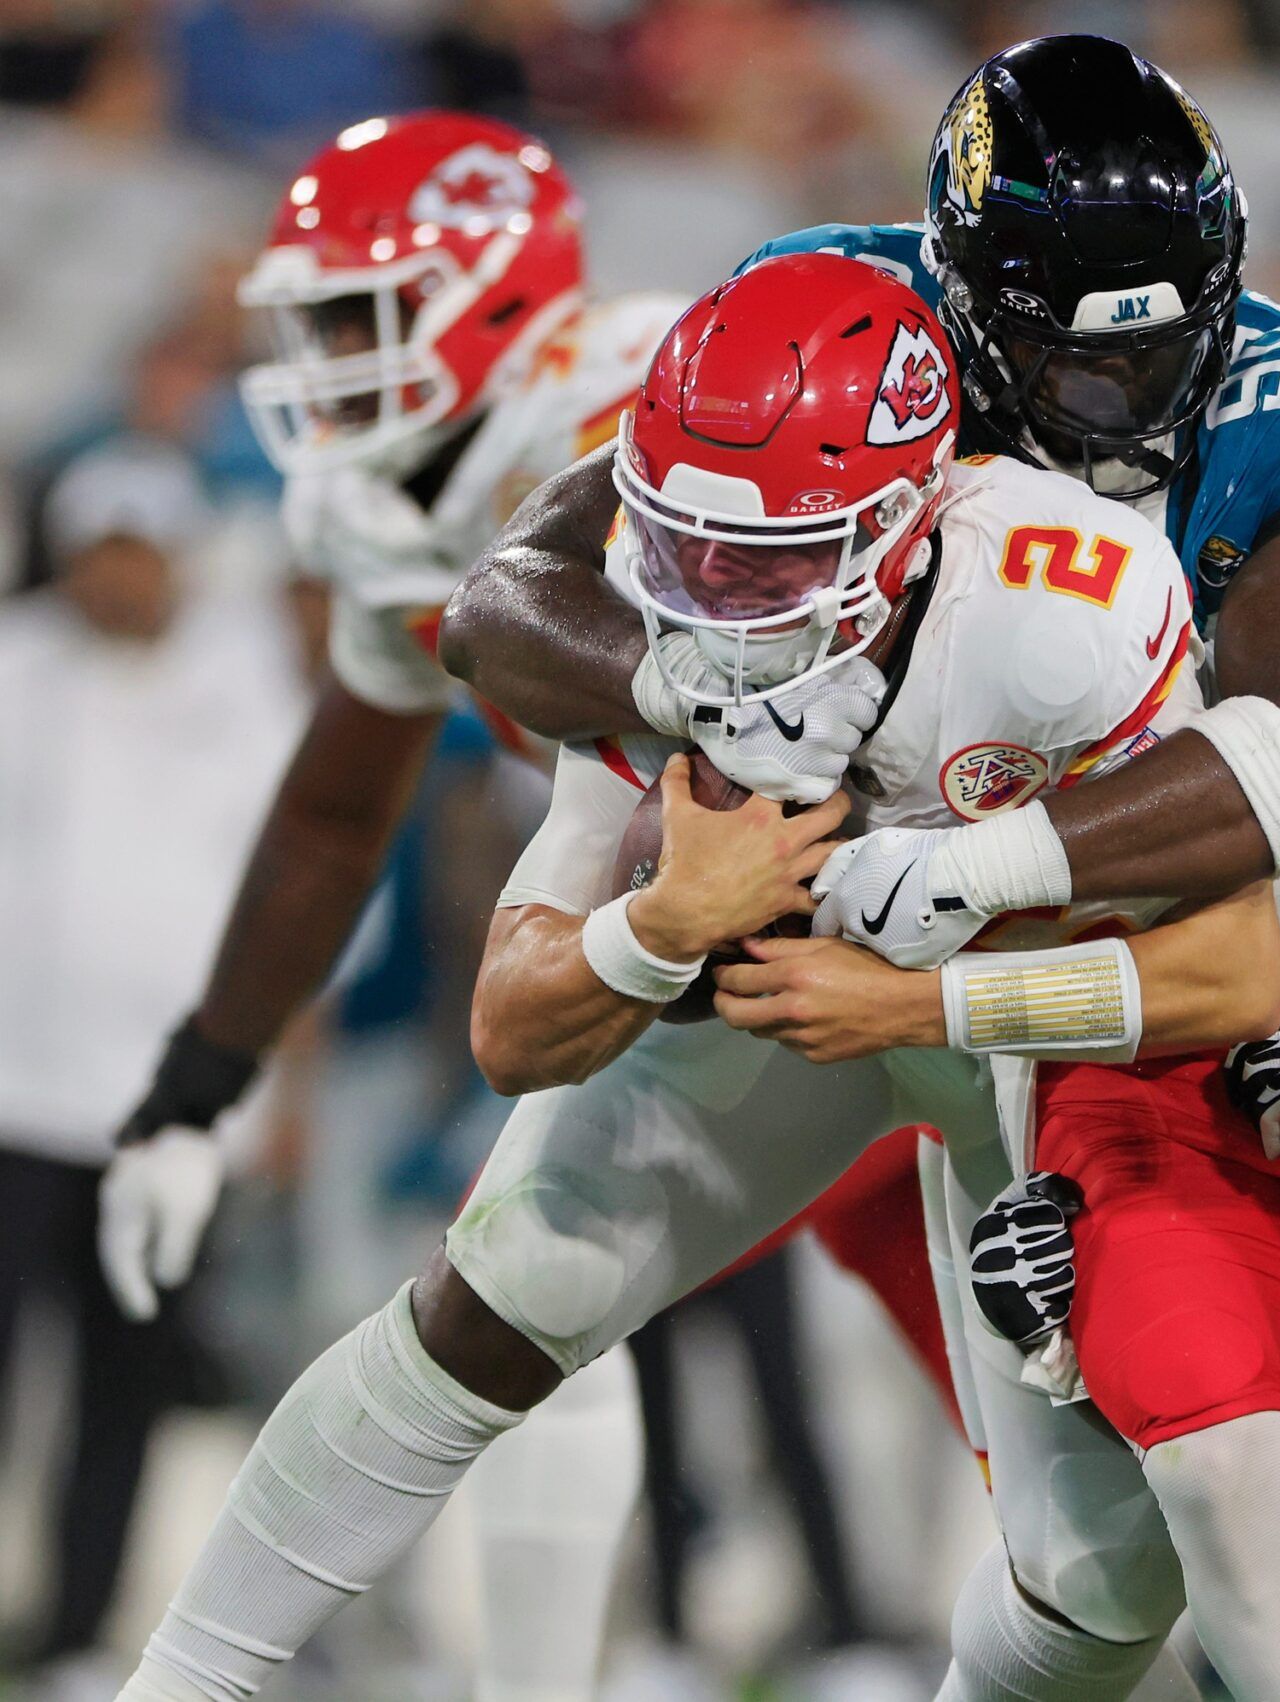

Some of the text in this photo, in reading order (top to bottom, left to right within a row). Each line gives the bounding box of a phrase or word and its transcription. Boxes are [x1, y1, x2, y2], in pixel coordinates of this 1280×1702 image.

[1000, 297, 1046, 318] OAKLEY
[1111, 295, 1151, 323] JAX
[790, 502, 844, 513] OAKLEY
[996, 524, 1134, 612] 2
